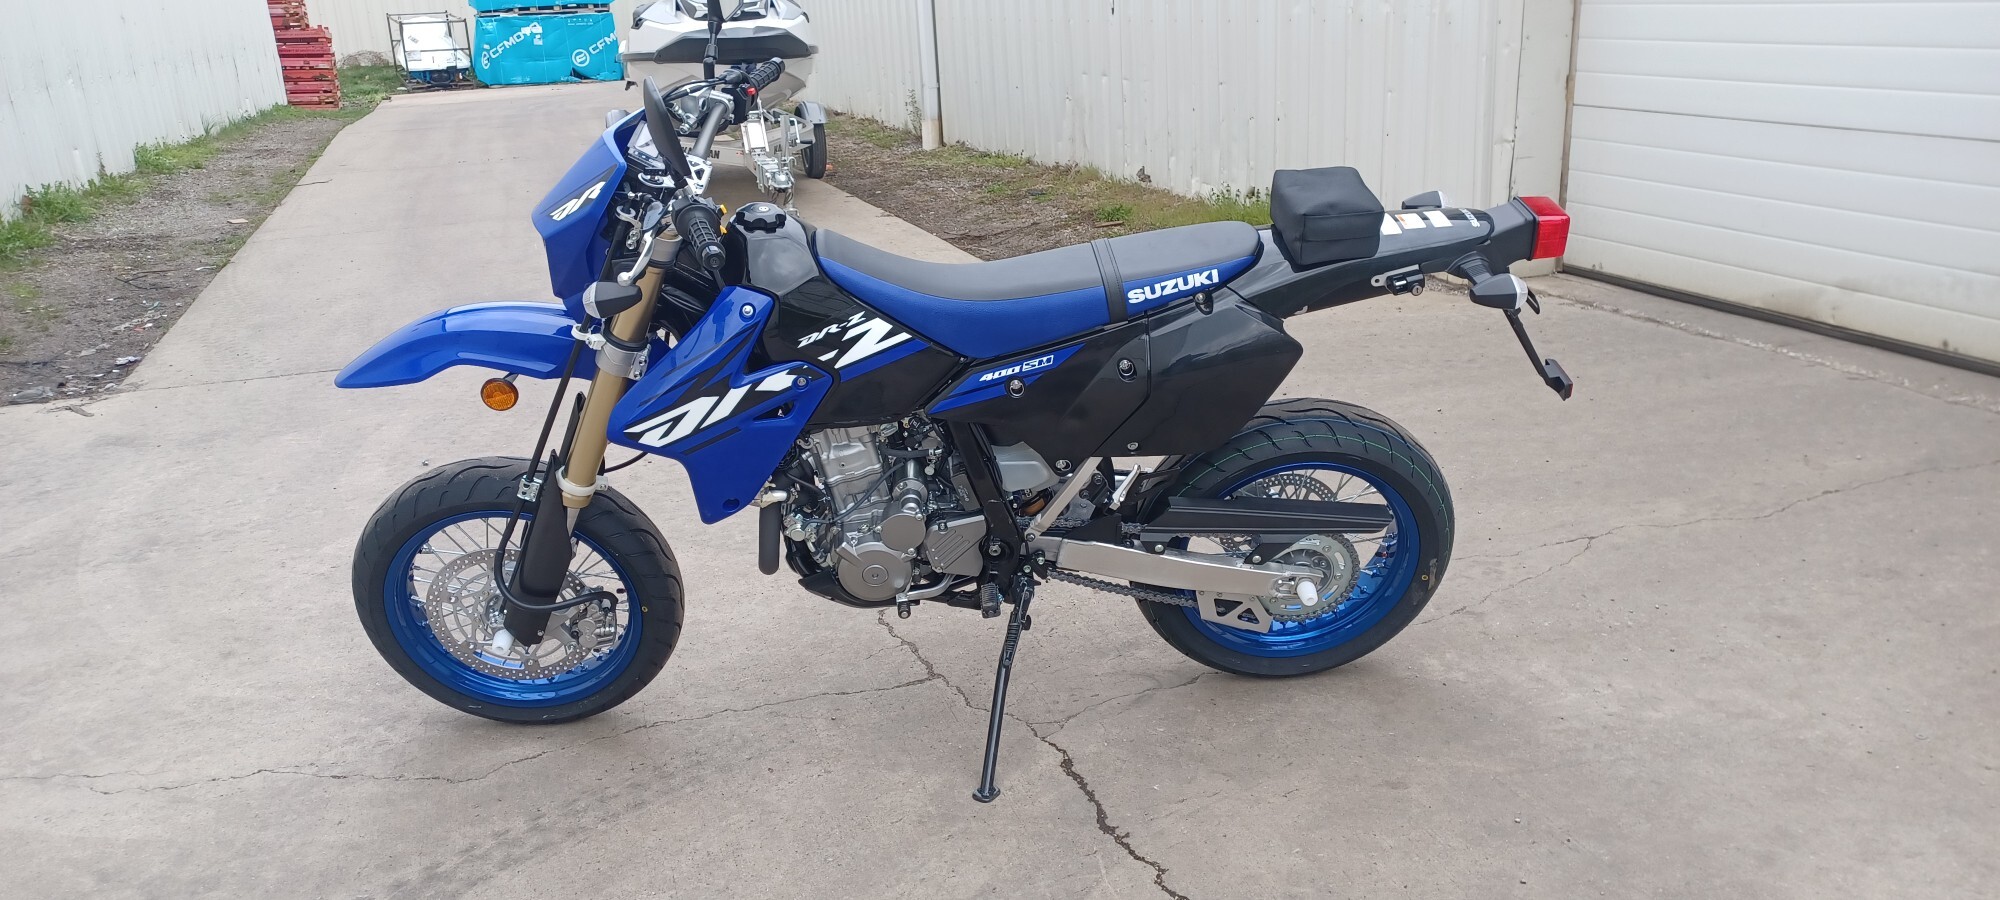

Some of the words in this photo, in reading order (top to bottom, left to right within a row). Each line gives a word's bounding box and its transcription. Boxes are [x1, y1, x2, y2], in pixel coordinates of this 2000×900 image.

[589, 31, 616, 55] CFM
[1127, 268, 1219, 304] SUZUKI
[797, 311, 866, 349] DR-Z
